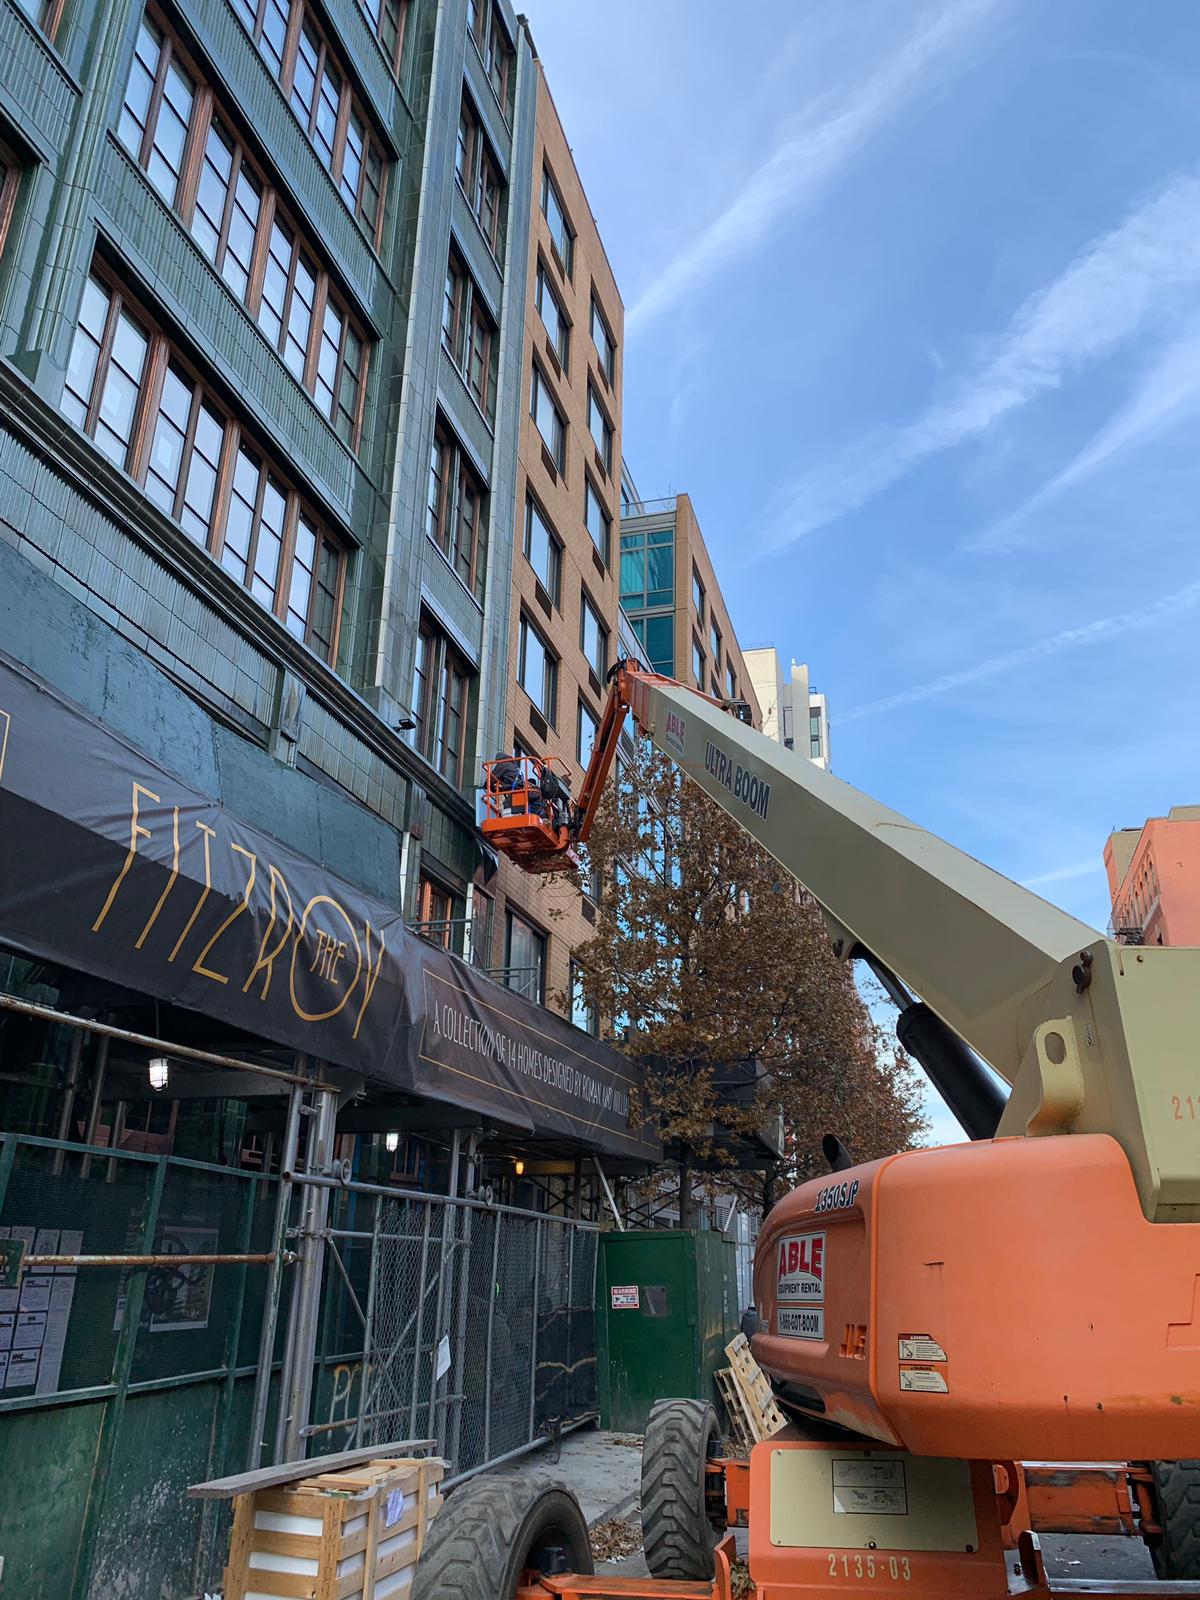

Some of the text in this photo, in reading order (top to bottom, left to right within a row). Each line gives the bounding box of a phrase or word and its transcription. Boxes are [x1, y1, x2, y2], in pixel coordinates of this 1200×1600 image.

[666, 711, 686, 744] ABLE
[704, 740, 771, 821] ULTRA BOOM
[91, 781, 386, 1040] FITZROY
[309, 928, 348, 985] THE
[433, 999, 441, 1035] A
[442, 1004, 496, 1059] COLLECTION
[495, 1032, 507, 1064] OF
[507, 1038, 517, 1070] 14
[517, 1041, 543, 1081] HOMES
[543, 1055, 575, 1094] DESIGNED
[574, 1070, 583, 1098] BY
[815, 1179, 860, 1213] 1350SJP
[778, 1237, 824, 1283] ABLE
[778, 1282, 822, 1294] EQUIPMENT RENTAL
